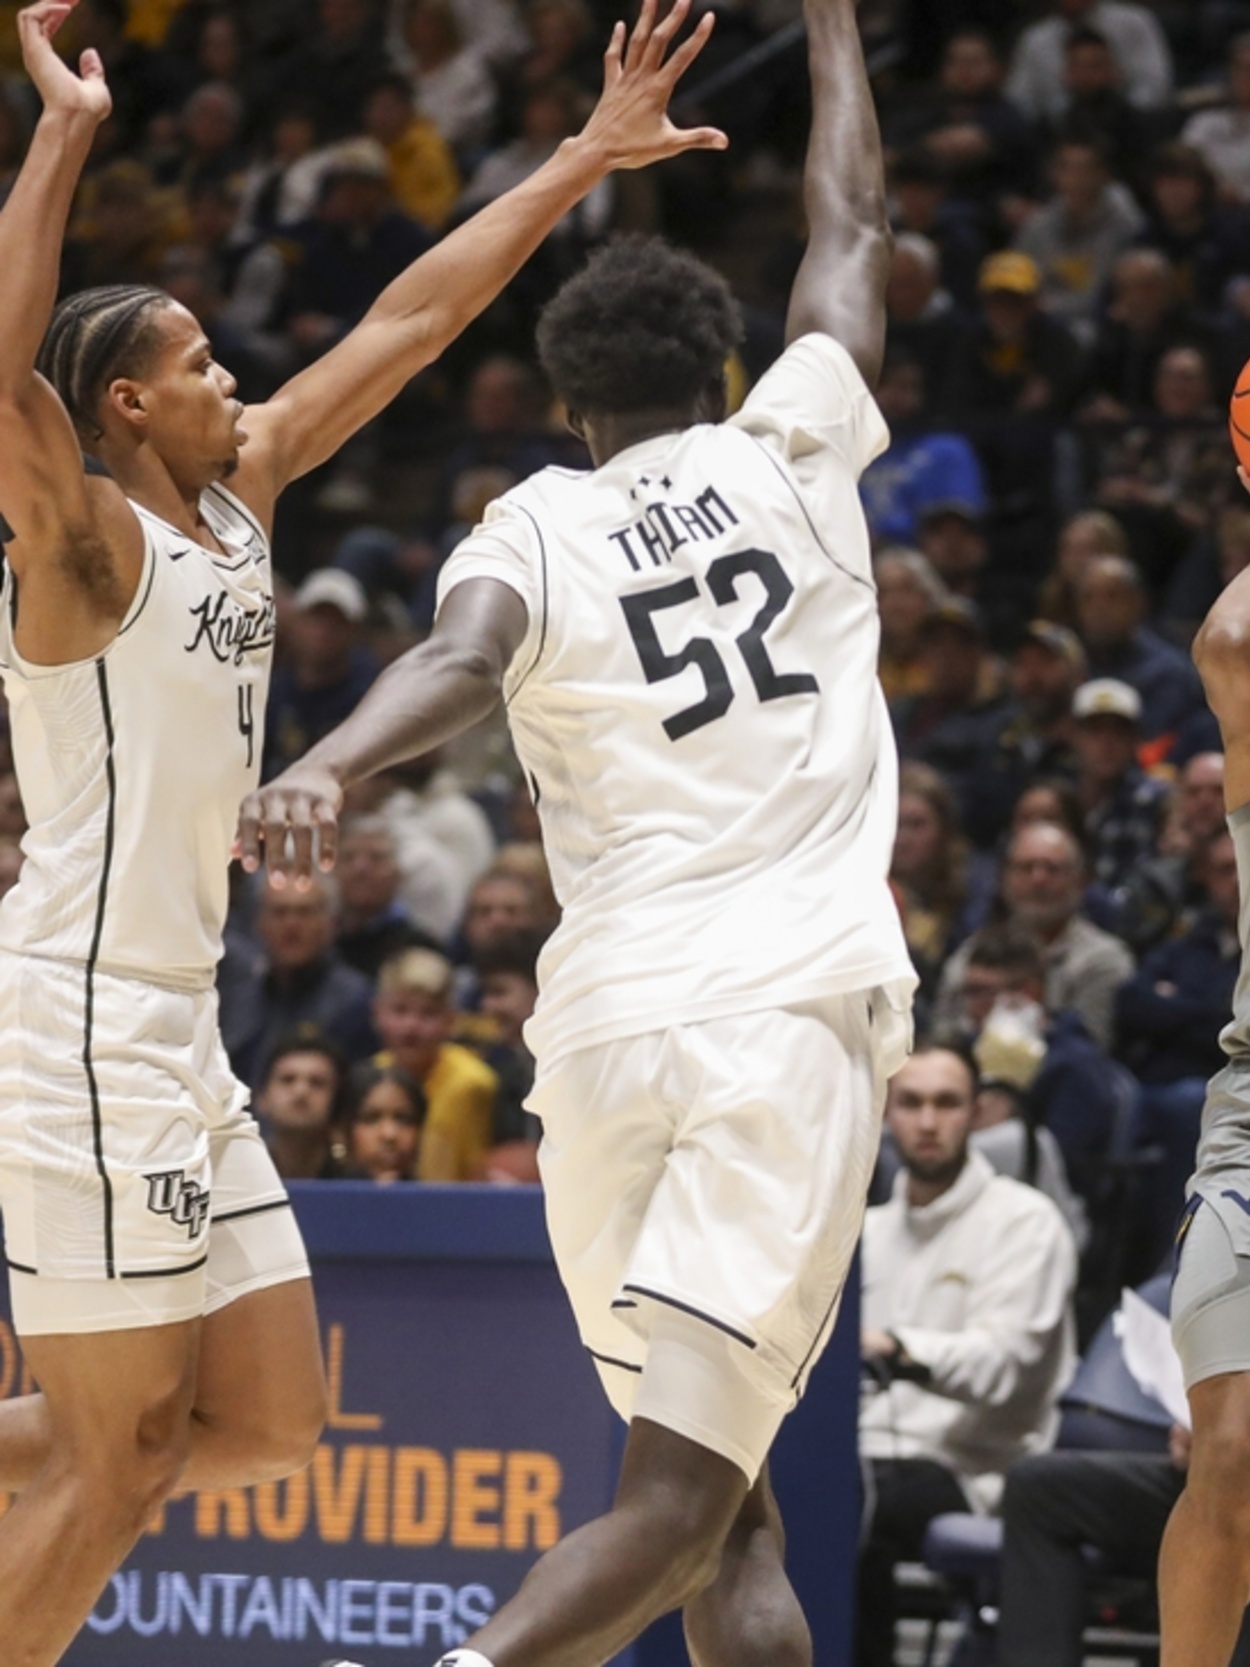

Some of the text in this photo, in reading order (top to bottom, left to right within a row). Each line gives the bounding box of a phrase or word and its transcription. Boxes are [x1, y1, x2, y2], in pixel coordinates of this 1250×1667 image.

[607, 484, 740, 572] THIAM
[618, 547, 820, 742] 52
[238, 683, 254, 768] 4
[141, 1169, 210, 1240] UCF
[144, 1445, 562, 1551] ROVIDER
[86, 1569, 496, 1649] OUNTAINEERS
